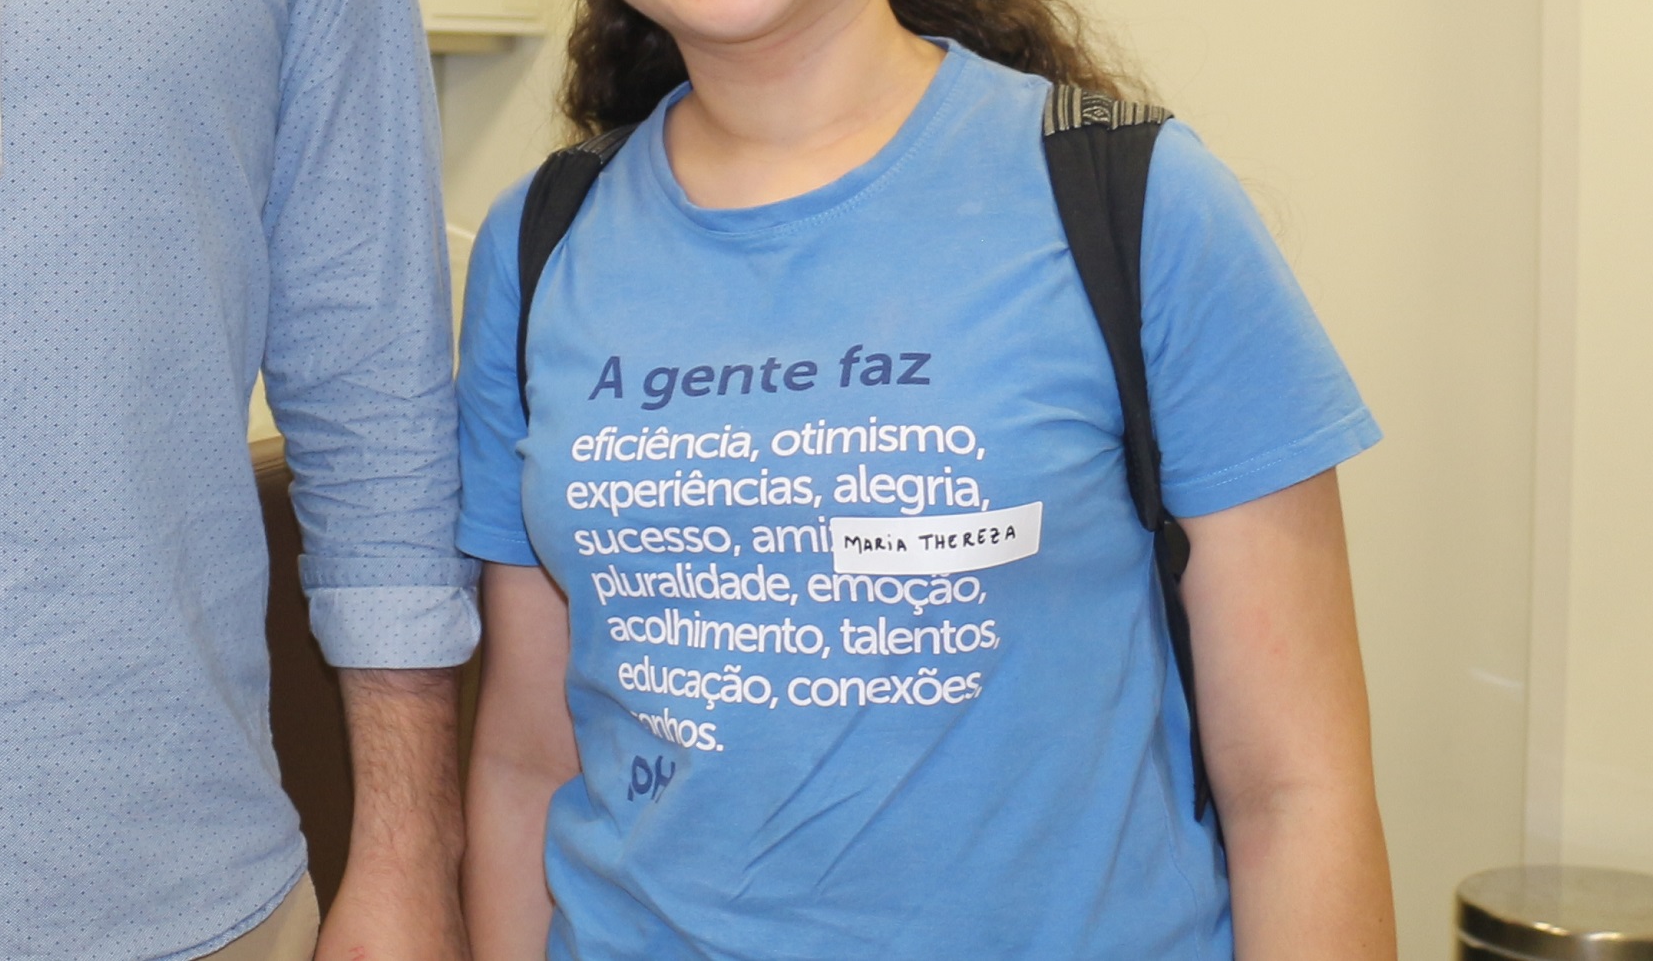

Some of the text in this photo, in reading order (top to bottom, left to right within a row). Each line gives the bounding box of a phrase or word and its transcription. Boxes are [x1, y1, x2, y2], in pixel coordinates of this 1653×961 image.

[588, 344, 932, 411] A gente faz
[571, 416, 986, 463] eficiência, otimismo,
[566, 464, 990, 517] experiências, alegria,
[574, 516, 834, 557] sucesso, ami
[918, 525, 1017, 551] THEREZA
[591, 563, 987, 615] pluralidade, emoção,
[607, 608, 1000, 659] acolhimento, talentos,
[618, 655, 983, 710] educação, conexões,
